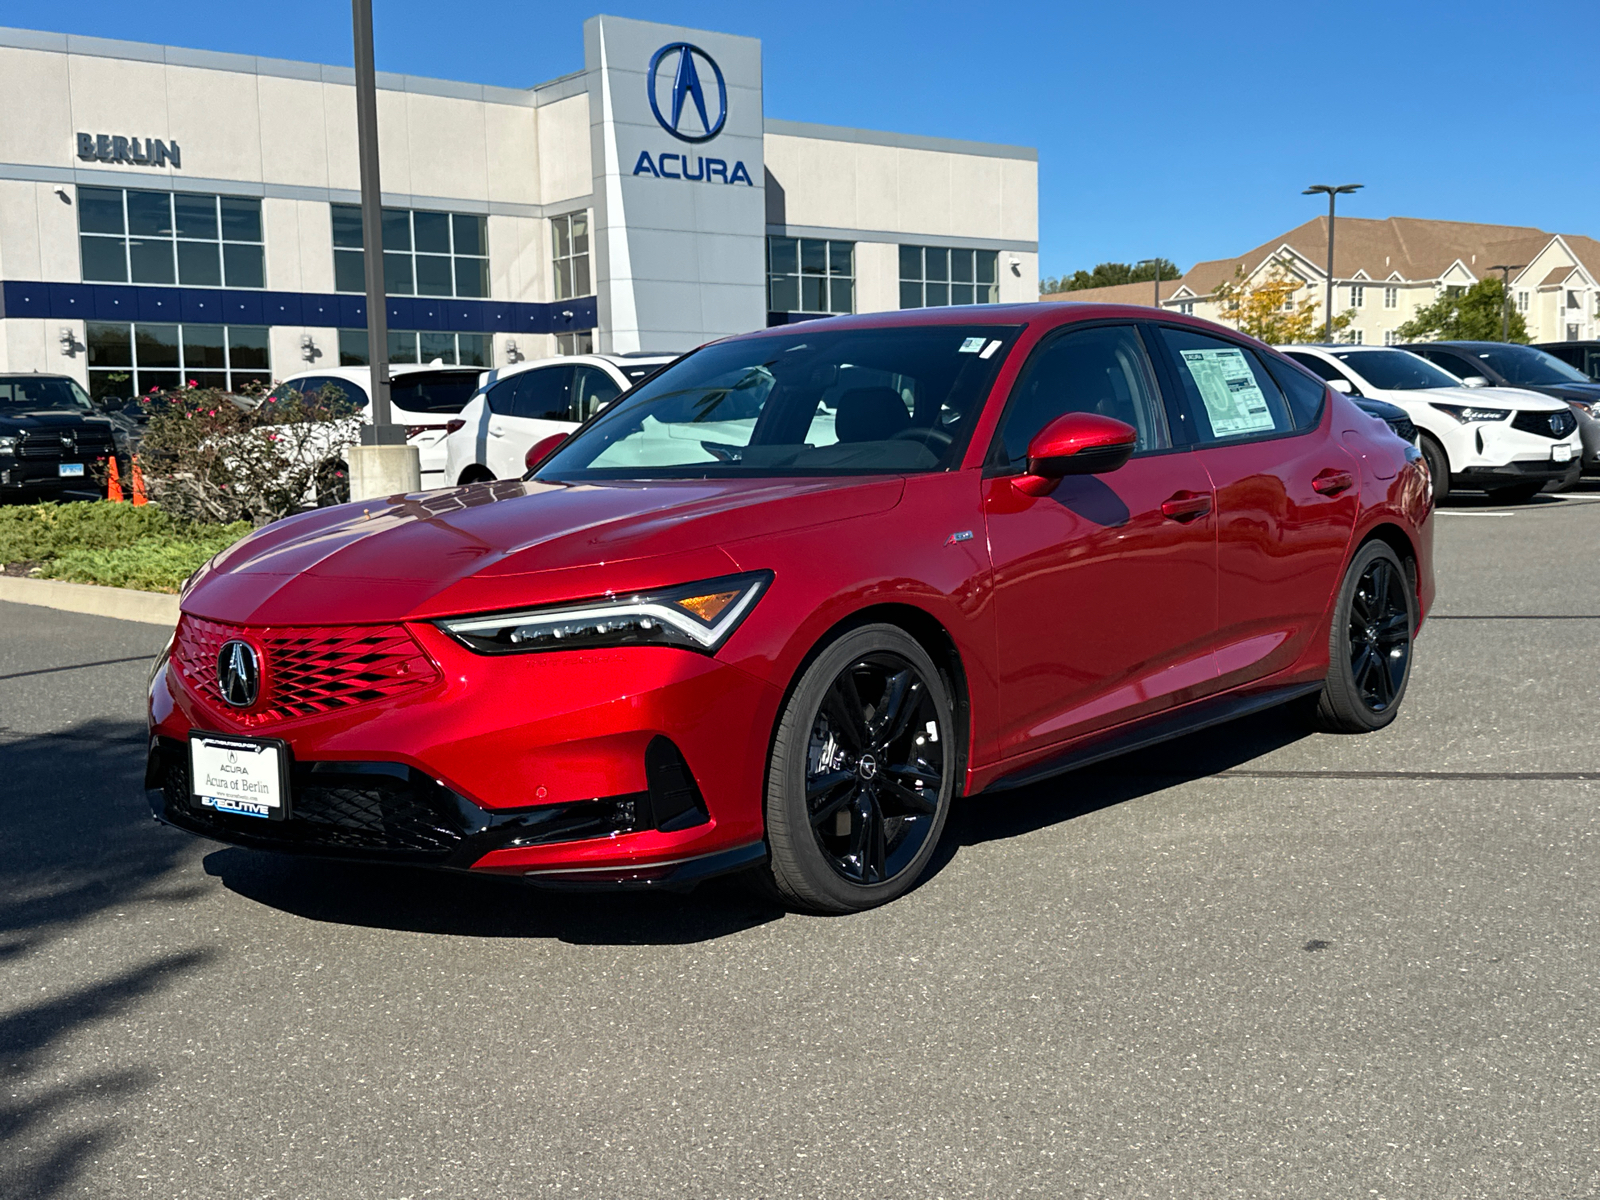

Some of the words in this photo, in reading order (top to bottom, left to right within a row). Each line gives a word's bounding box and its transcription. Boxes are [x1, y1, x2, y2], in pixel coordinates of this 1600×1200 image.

[76, 132, 181, 169] BERLIN
[632, 150, 753, 186] ACURA
[220, 764, 249, 775] ACURA
[205, 774, 228, 788] Acura
[230, 780, 239, 790] of
[242, 779, 269, 794] Berlin
[201, 796, 269, 815] EXECUTIVE
